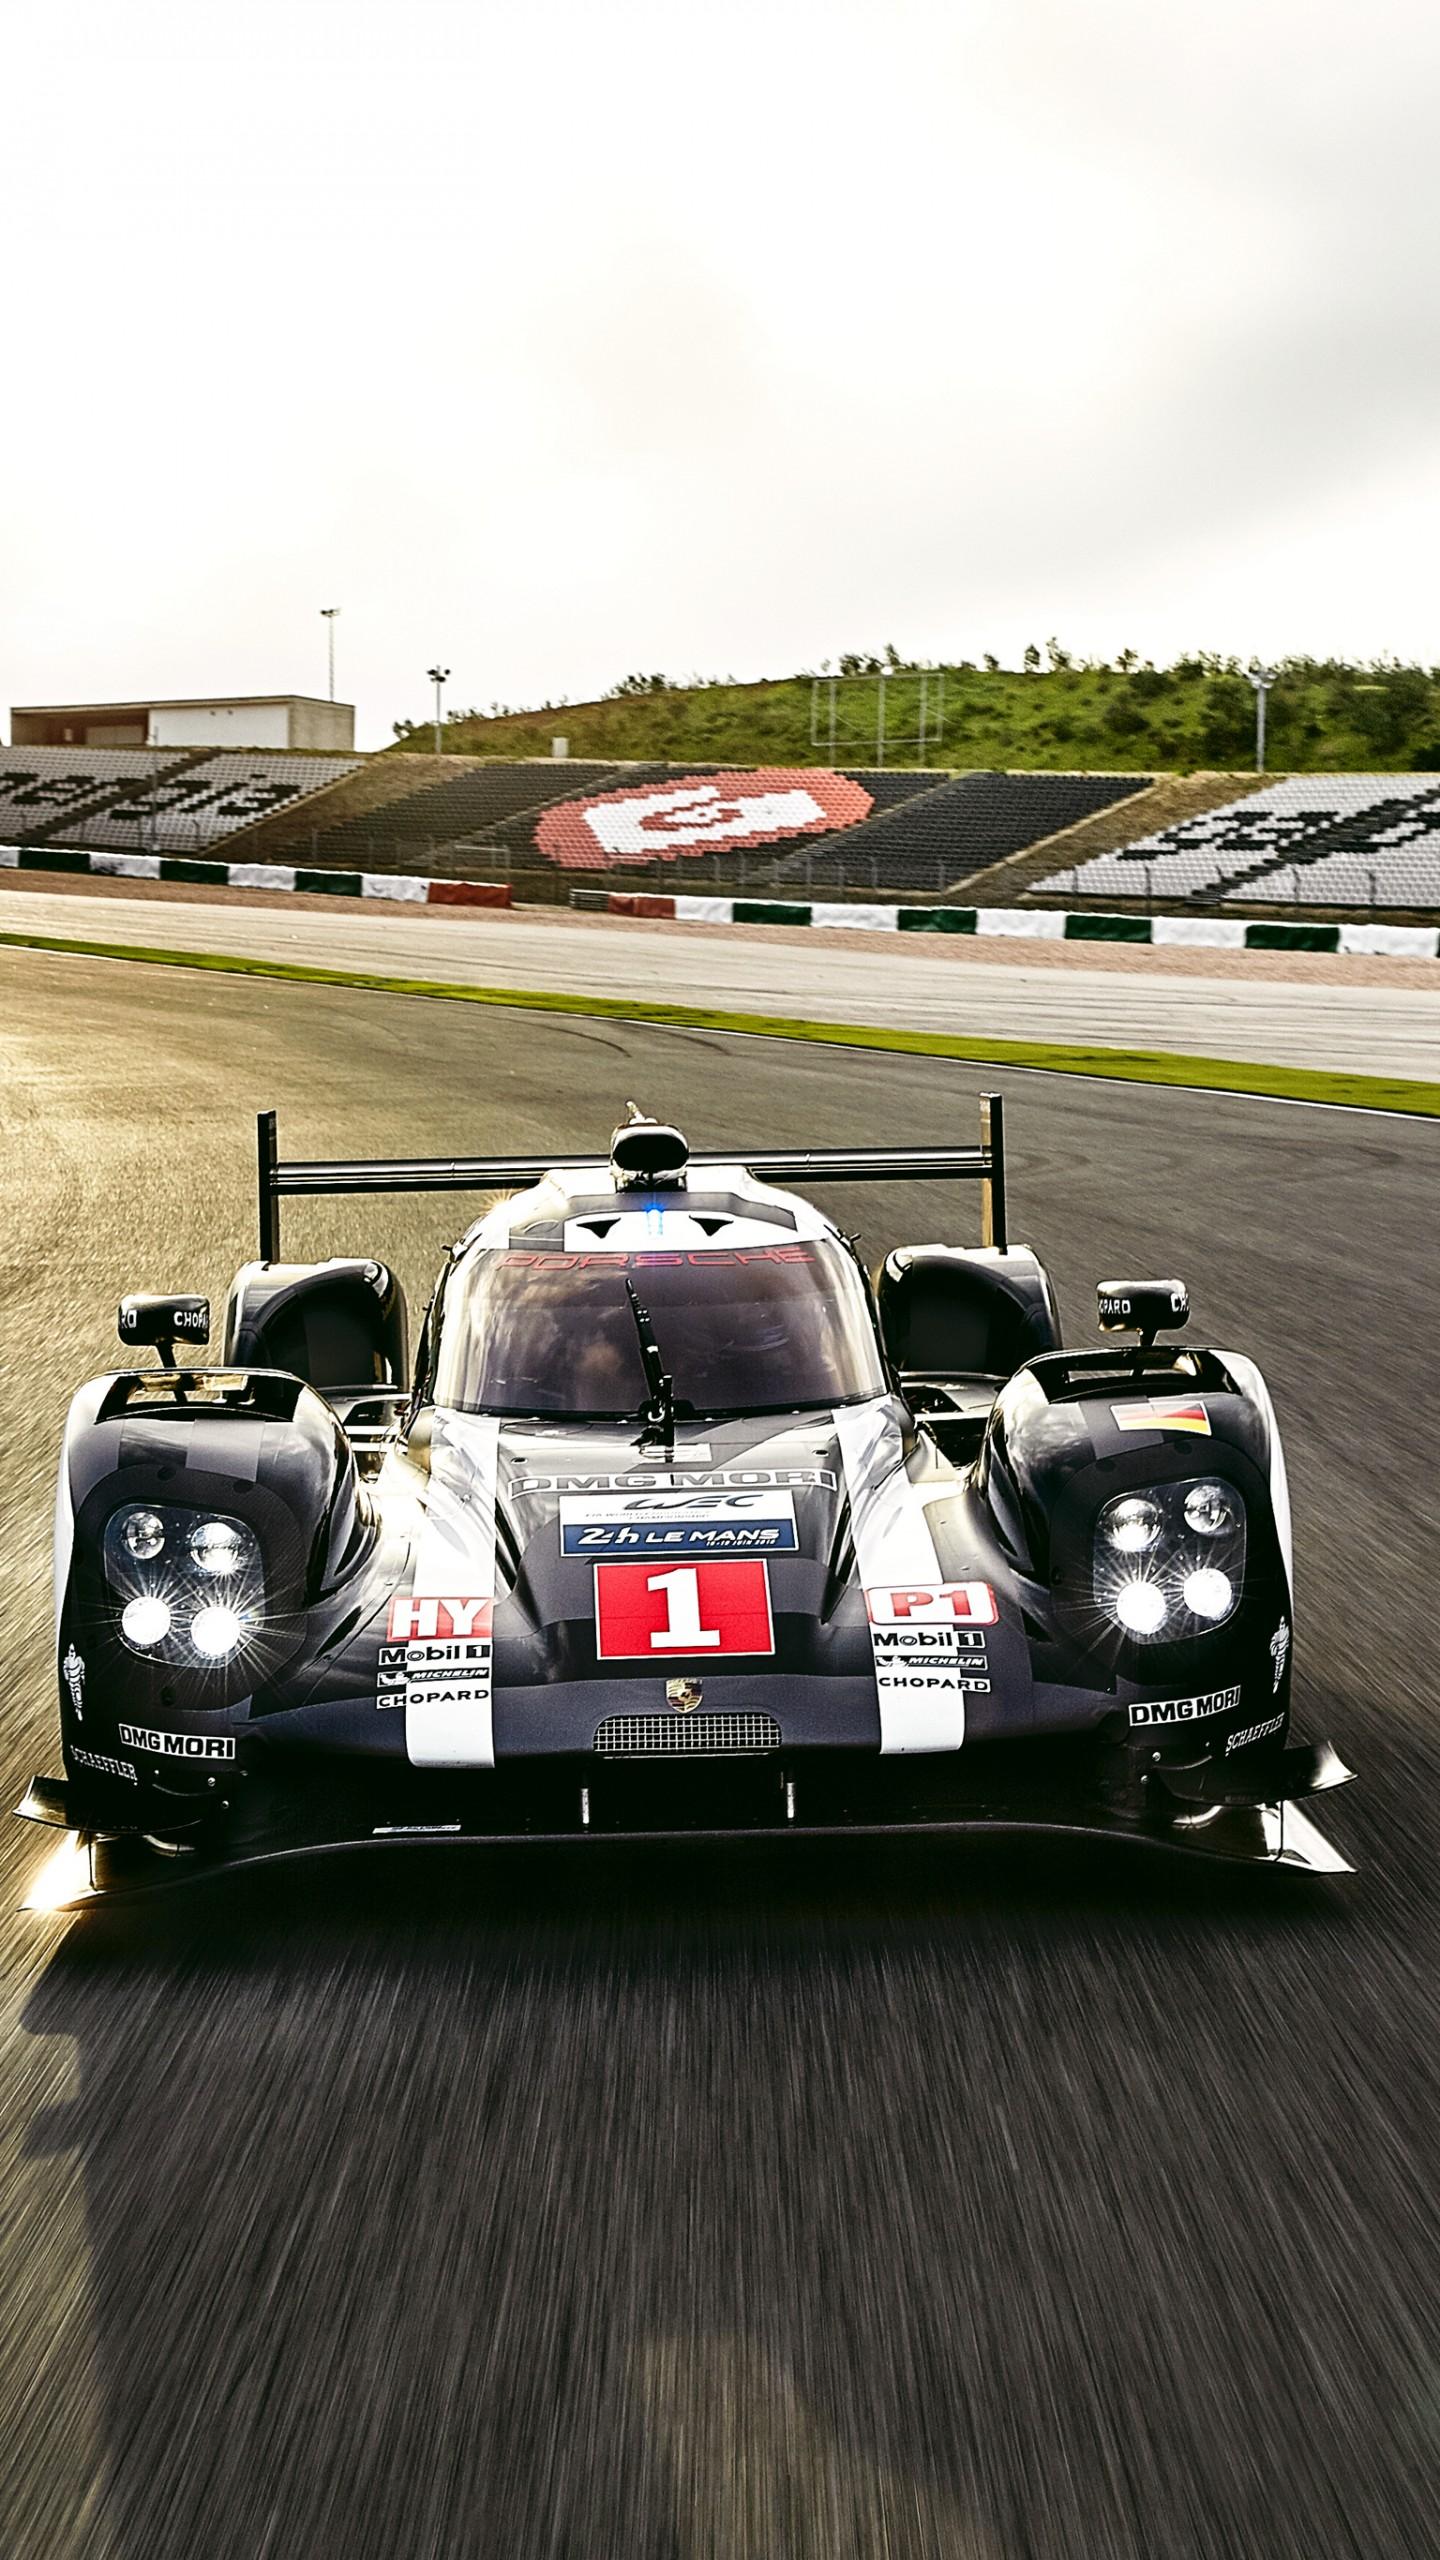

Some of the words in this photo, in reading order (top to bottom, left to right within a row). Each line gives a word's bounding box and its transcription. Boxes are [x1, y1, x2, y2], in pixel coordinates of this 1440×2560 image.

[496, 1247, 816, 1271] PORSCHE
[511, 1475, 656, 1497] DMG
[671, 1471, 834, 1488] MORI
[623, 1494, 763, 1511] WEC
[645, 1531, 686, 1543] LE
[689, 1528, 780, 1542] MANS
[646, 1567, 721, 1648] 1
[890, 1590, 971, 1617] P1
[391, 1599, 489, 1638] HY
[873, 1632, 953, 1646] Mobil
[957, 1632, 983, 1647] 1
[380, 1645, 460, 1663] Mobil
[466, 1645, 490, 1659] 1
[908, 1657, 984, 1666] MICHELIN
[411, 1669, 488, 1681] MICHELIN
[878, 1677, 988, 1691] CHOPARD
[379, 1690, 489, 1707] CHOPARD
[1131, 1701, 1193, 1724] DMG
[1196, 1688, 1240, 1717] MORI
[121, 1725, 160, 1749] DMG
[164, 1735, 233, 1757] MORI
